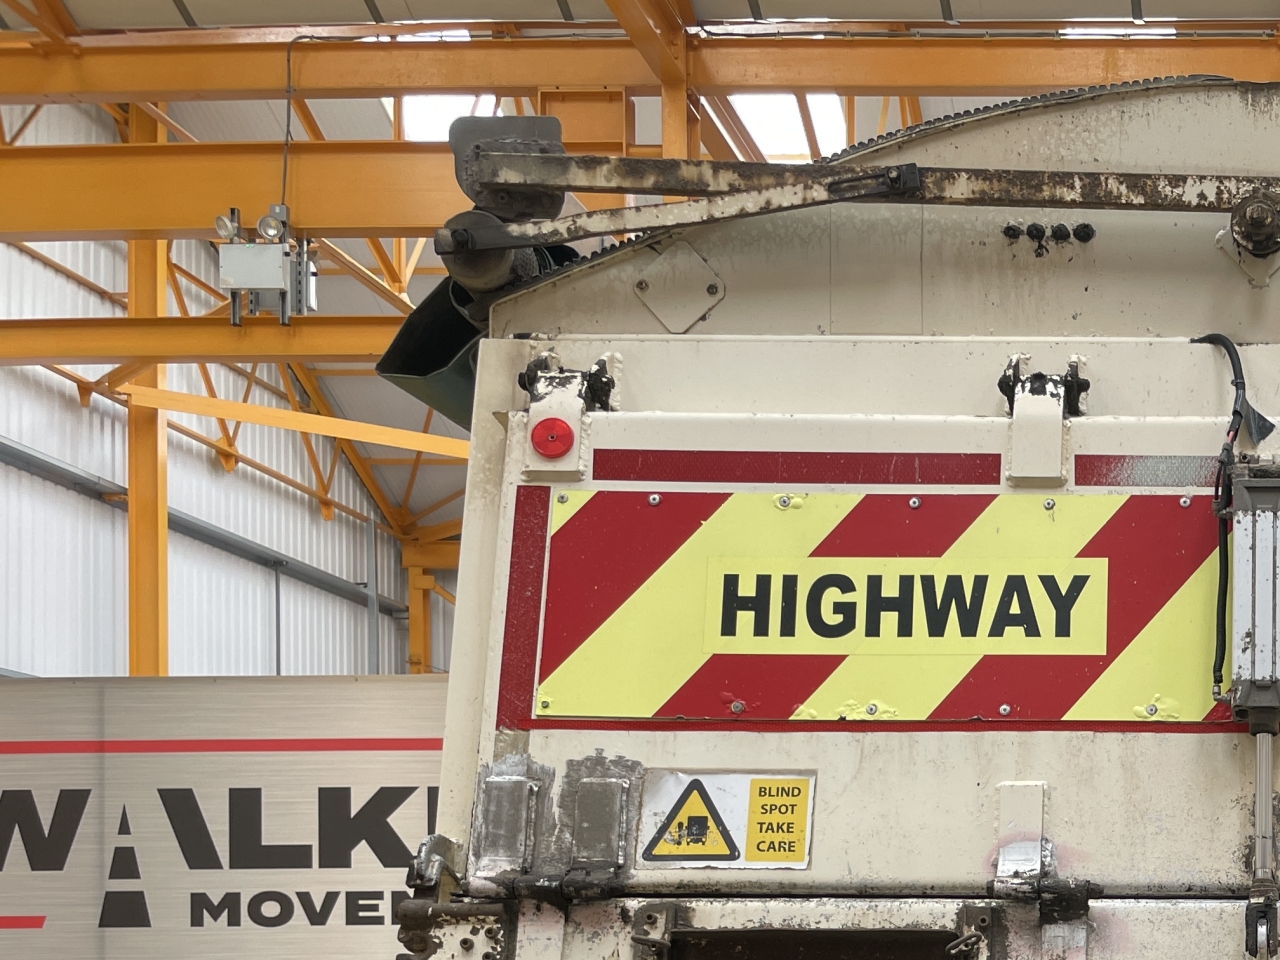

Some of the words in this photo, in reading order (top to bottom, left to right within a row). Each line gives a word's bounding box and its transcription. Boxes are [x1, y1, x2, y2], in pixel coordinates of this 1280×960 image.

[720, 573, 1091, 639] HIGHWAY
[758, 786, 802, 798] BLIND
[761, 803, 797, 815] SPOT
[757, 822, 794, 834] TAKE
[756, 840, 796, 853] CARE
[0, 782, 440, 927] WALK
